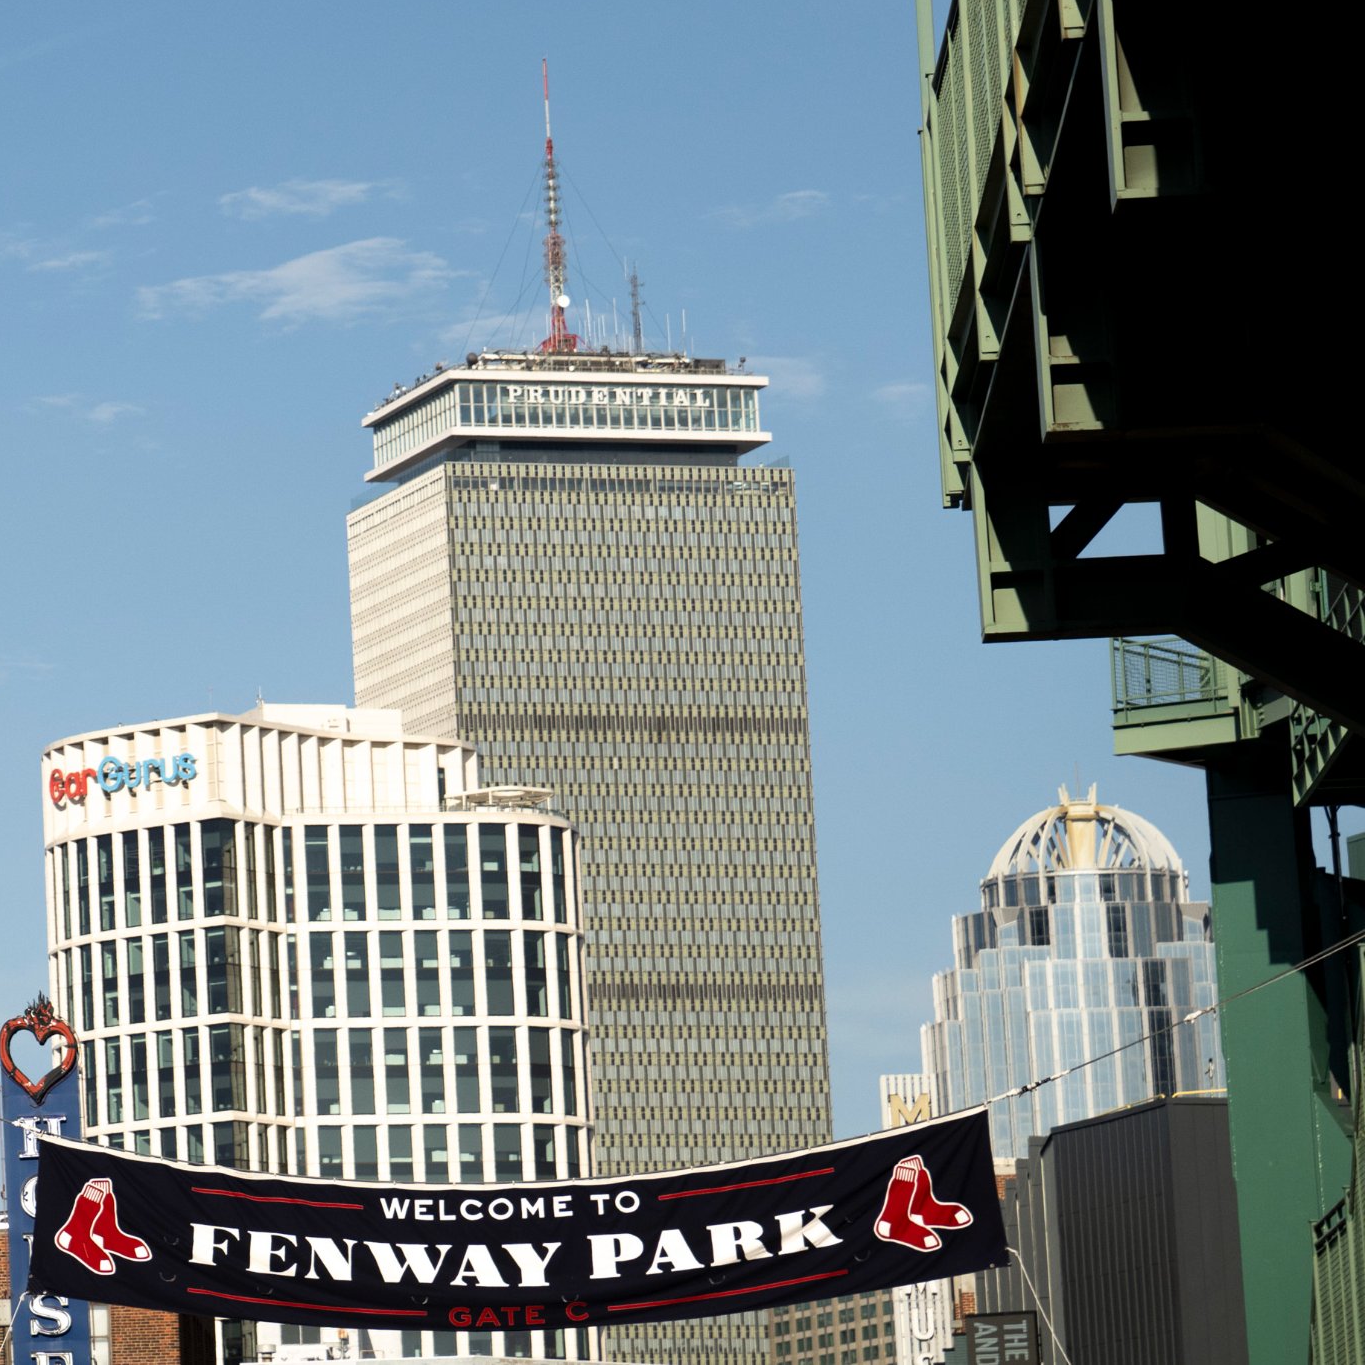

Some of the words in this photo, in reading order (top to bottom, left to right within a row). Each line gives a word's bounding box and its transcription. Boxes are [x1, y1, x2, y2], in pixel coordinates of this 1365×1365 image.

[505, 385, 710, 407] PRUDENTIAL
[49, 752, 197, 803] CarGurus
[380, 1194, 573, 1221] WELCOME
[590, 1190, 641, 1216] TO
[189, 1222, 562, 1287] FENWAY
[587, 1204, 844, 1280] PARK
[448, 1305, 546, 1328] GATE
[565, 1301, 590, 1322] C
[1003, 1319, 1029, 1362] THE
